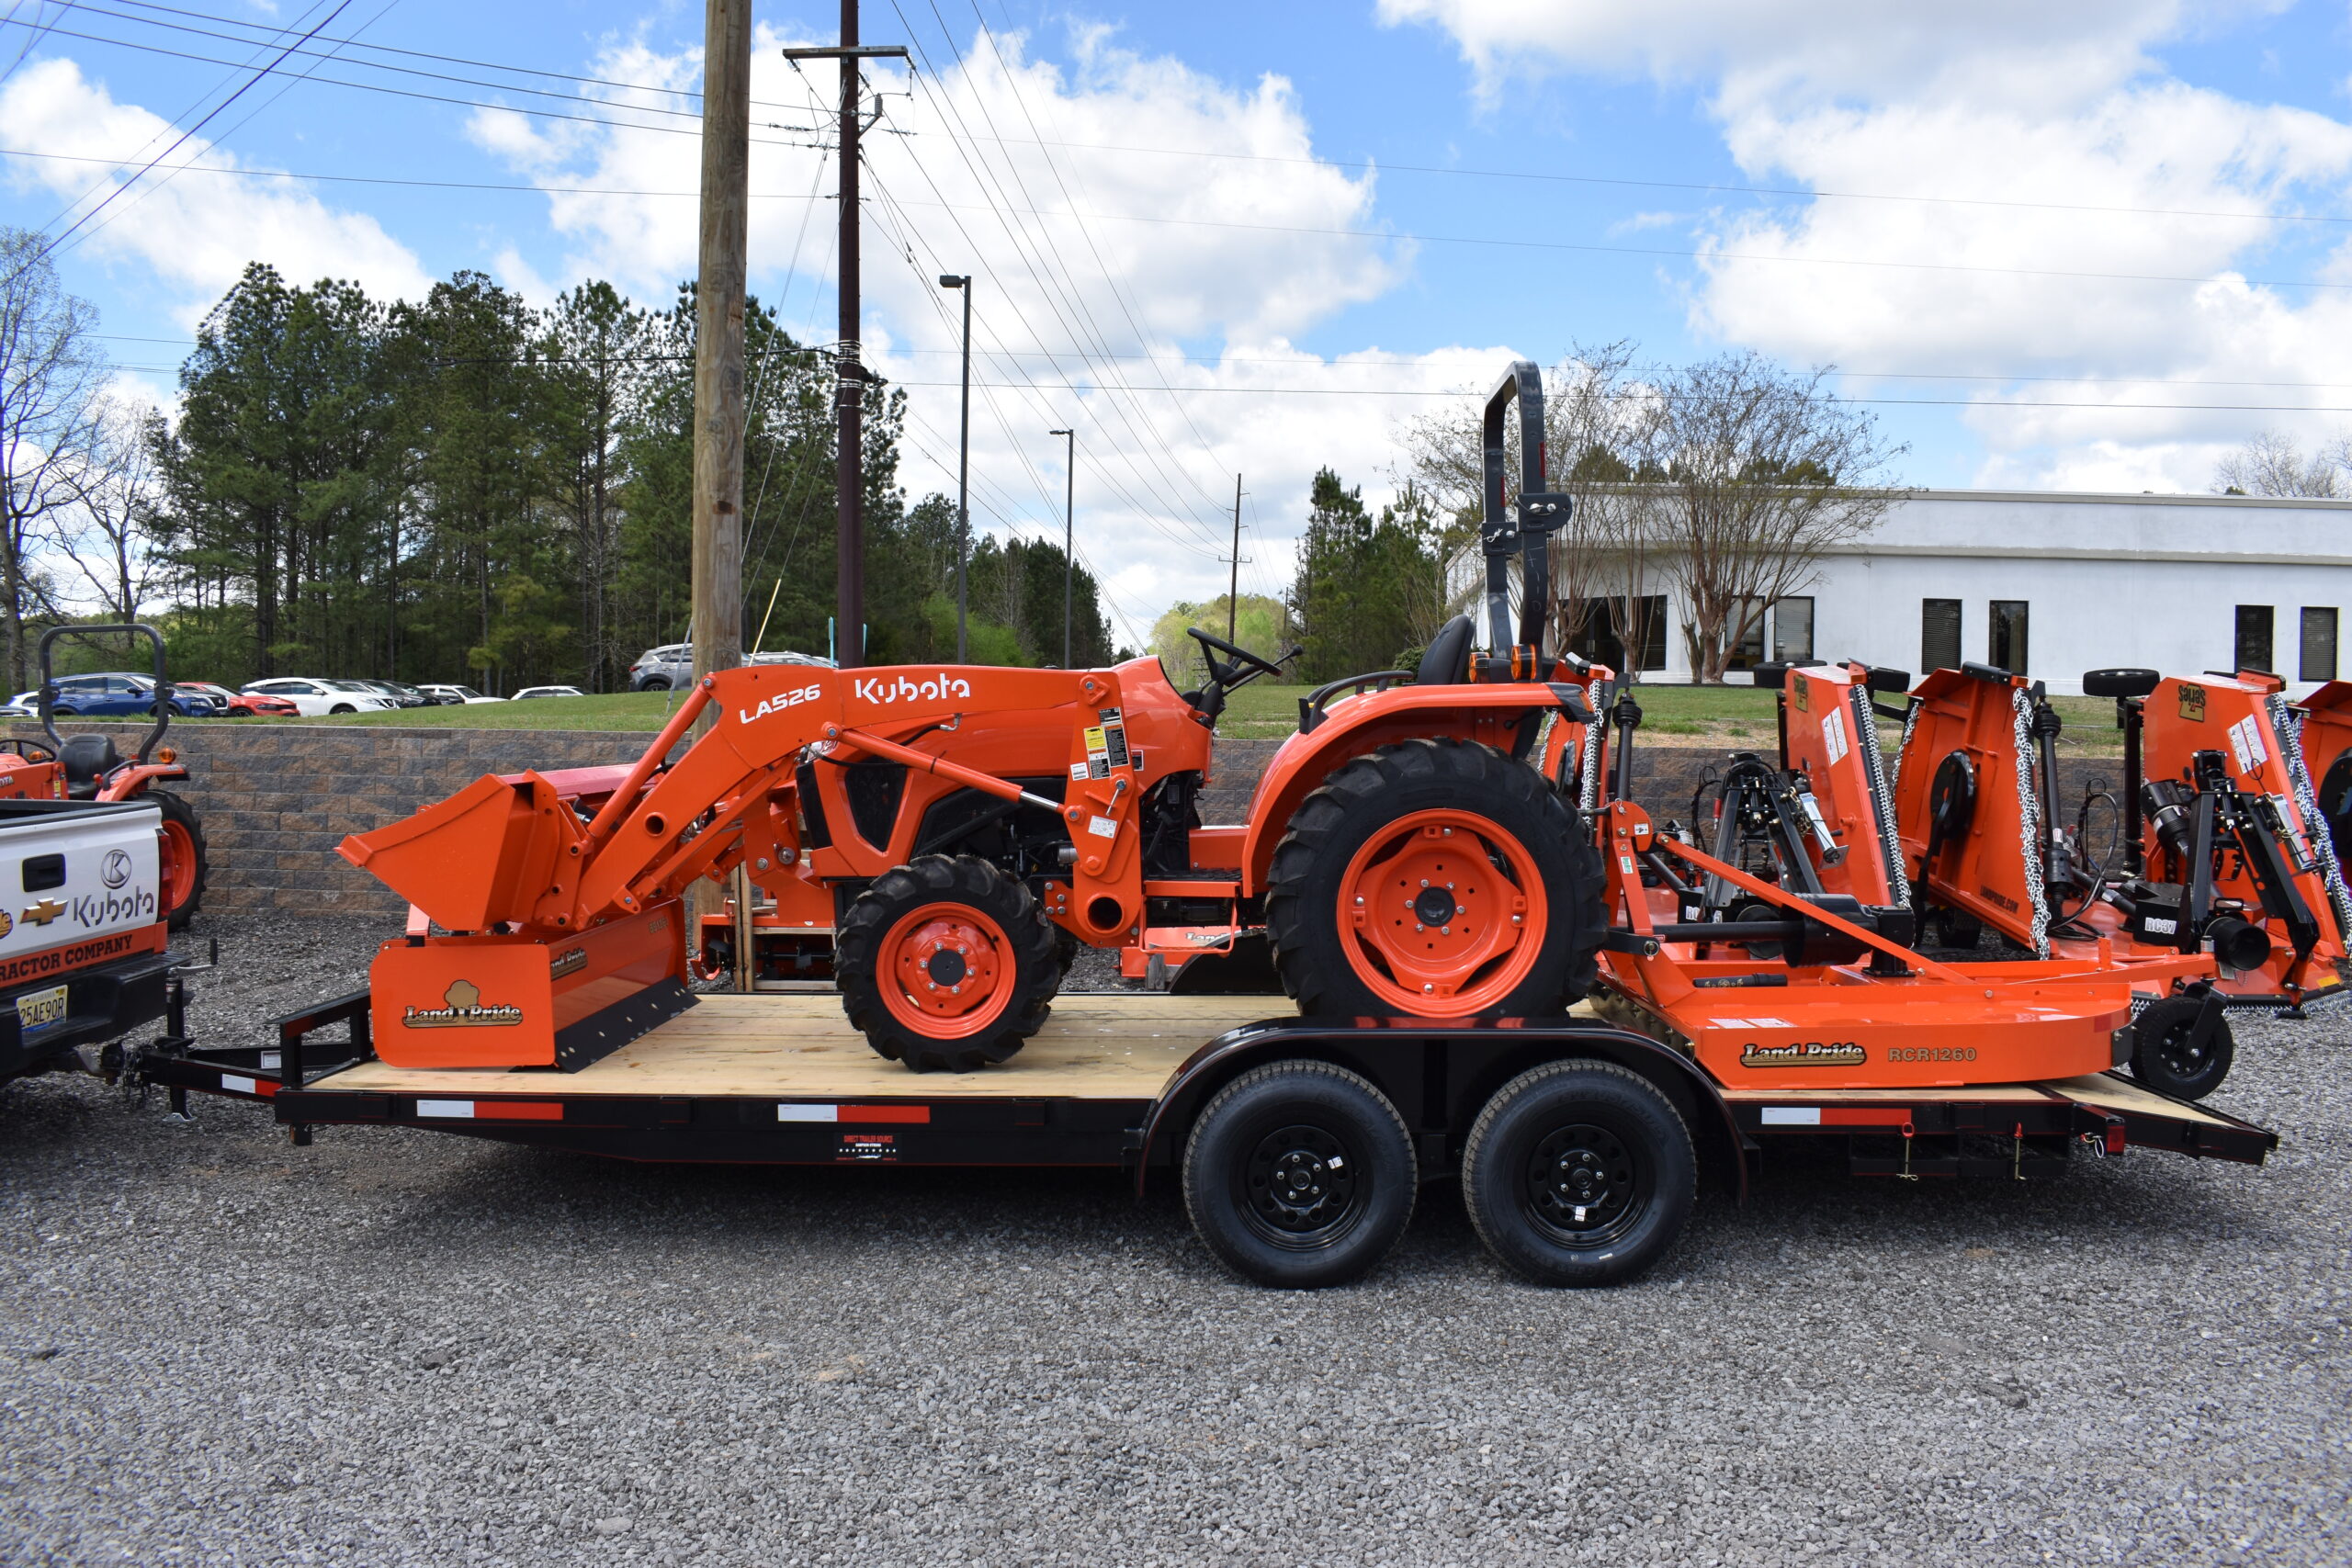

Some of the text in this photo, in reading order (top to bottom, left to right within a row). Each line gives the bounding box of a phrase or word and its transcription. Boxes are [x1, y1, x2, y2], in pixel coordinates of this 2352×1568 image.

[739, 683, 821, 725] LA526
[854, 672, 970, 705] Kubota
[73, 885, 154, 928] Kubota
[64, 933, 133, 965] COMPANY
[405, 1003, 522, 1022] Land Pride
[1745, 1042, 1865, 1061] Land Pride
[1888, 1046, 1977, 1062] RCR1260
